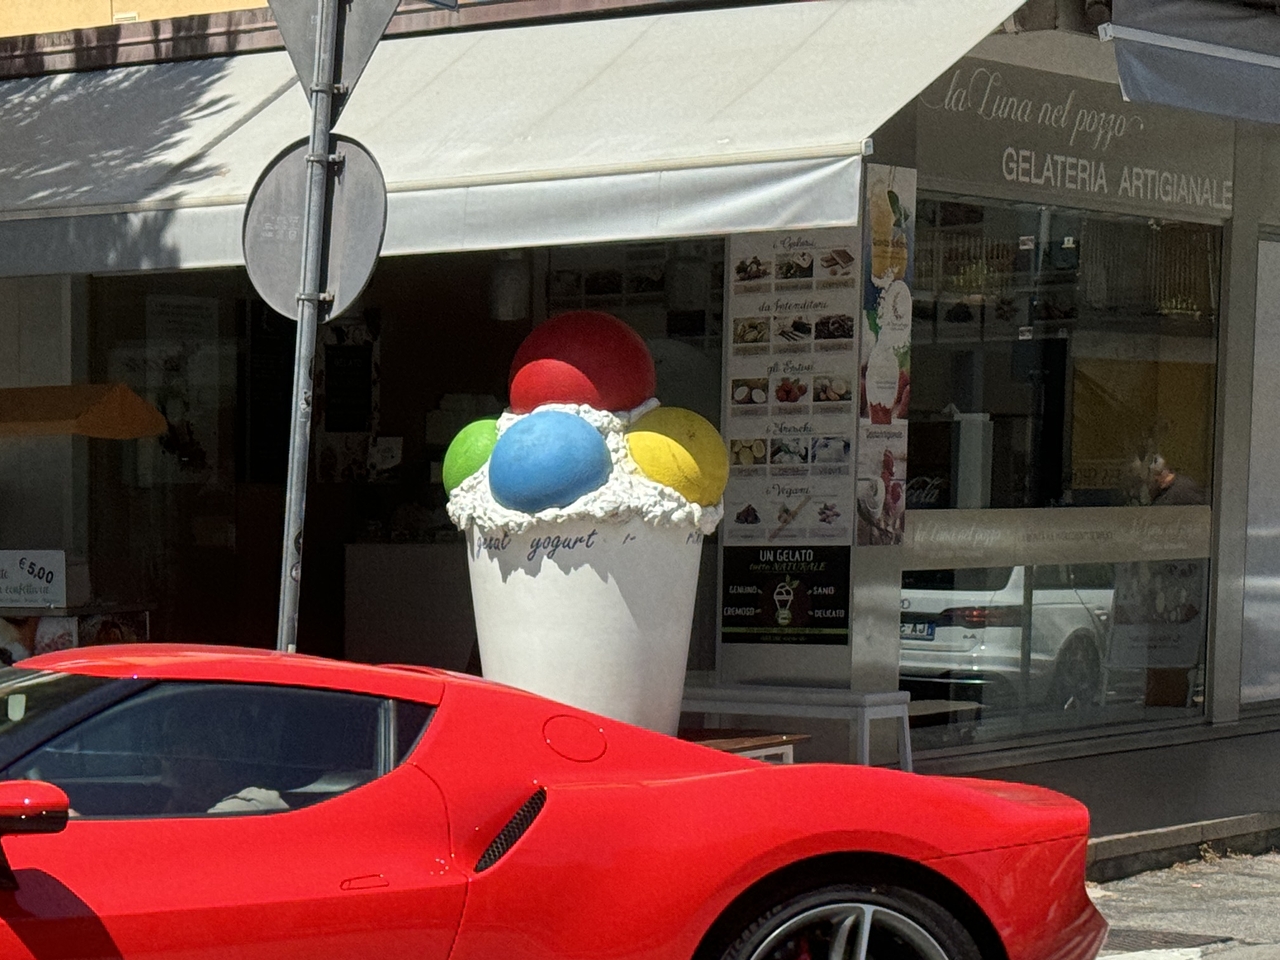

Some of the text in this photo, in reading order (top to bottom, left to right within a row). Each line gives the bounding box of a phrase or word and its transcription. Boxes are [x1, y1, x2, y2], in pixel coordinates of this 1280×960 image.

[1038, 90, 1073, 128] nel
[1002, 147, 1232, 210] GELATERIA ARTIGIANALE
[527, 528, 598, 561] yogurt
[760, 550, 813, 561] UN GELATO
[813, 586, 834, 594] SANO
[724, 607, 755, 616] CREMOSO
[814, 609, 845, 618] DELICATO
